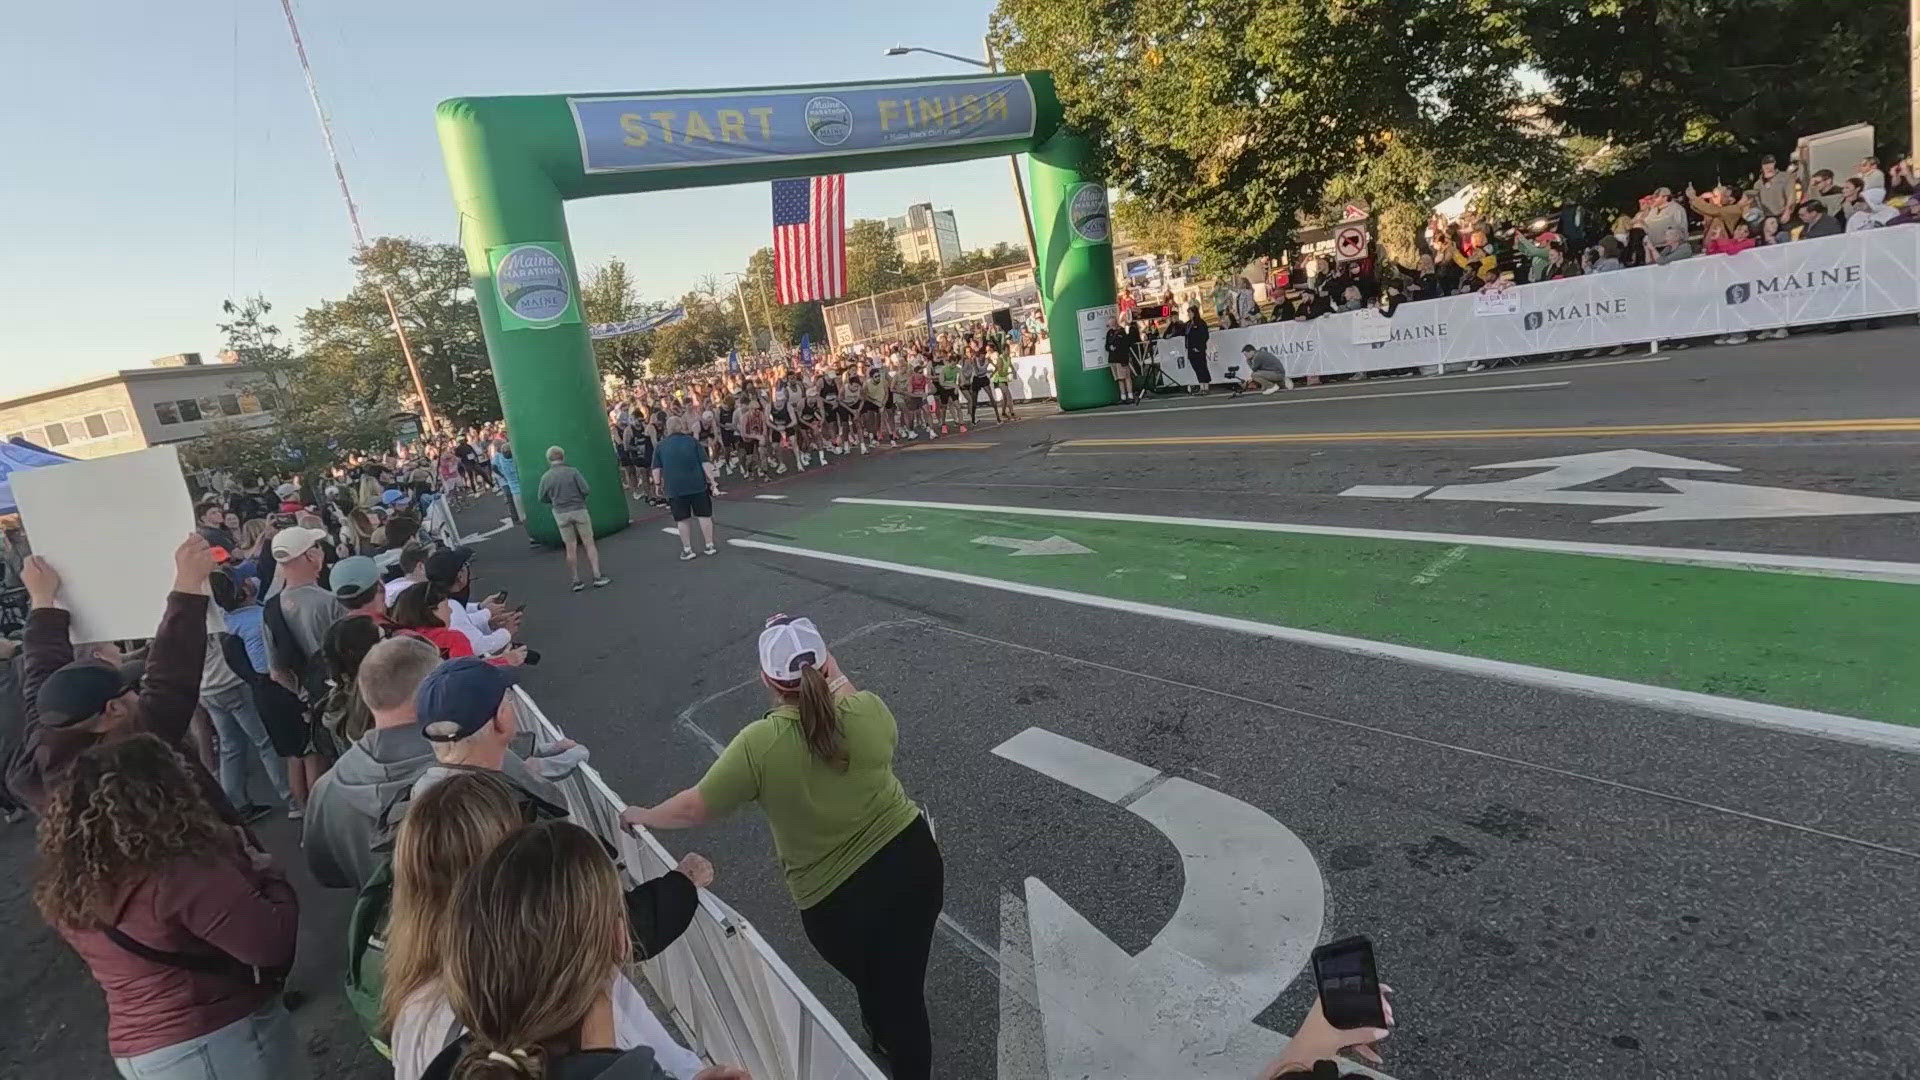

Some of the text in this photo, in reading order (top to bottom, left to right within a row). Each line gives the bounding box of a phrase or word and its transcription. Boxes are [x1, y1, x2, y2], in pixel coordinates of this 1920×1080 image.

[878, 93, 1008, 130] FINISH
[619, 107, 773, 148] START
[508, 254, 553, 270] Maine
[503, 267, 561, 279] MARATHON
[1756, 265, 1860, 294] MAINE
[521, 296, 558, 307] MAINE
[1547, 298, 1627, 322] MAINE
[1390, 323, 1448, 342] MAINE
[1269, 340, 1315, 356] MAINE
